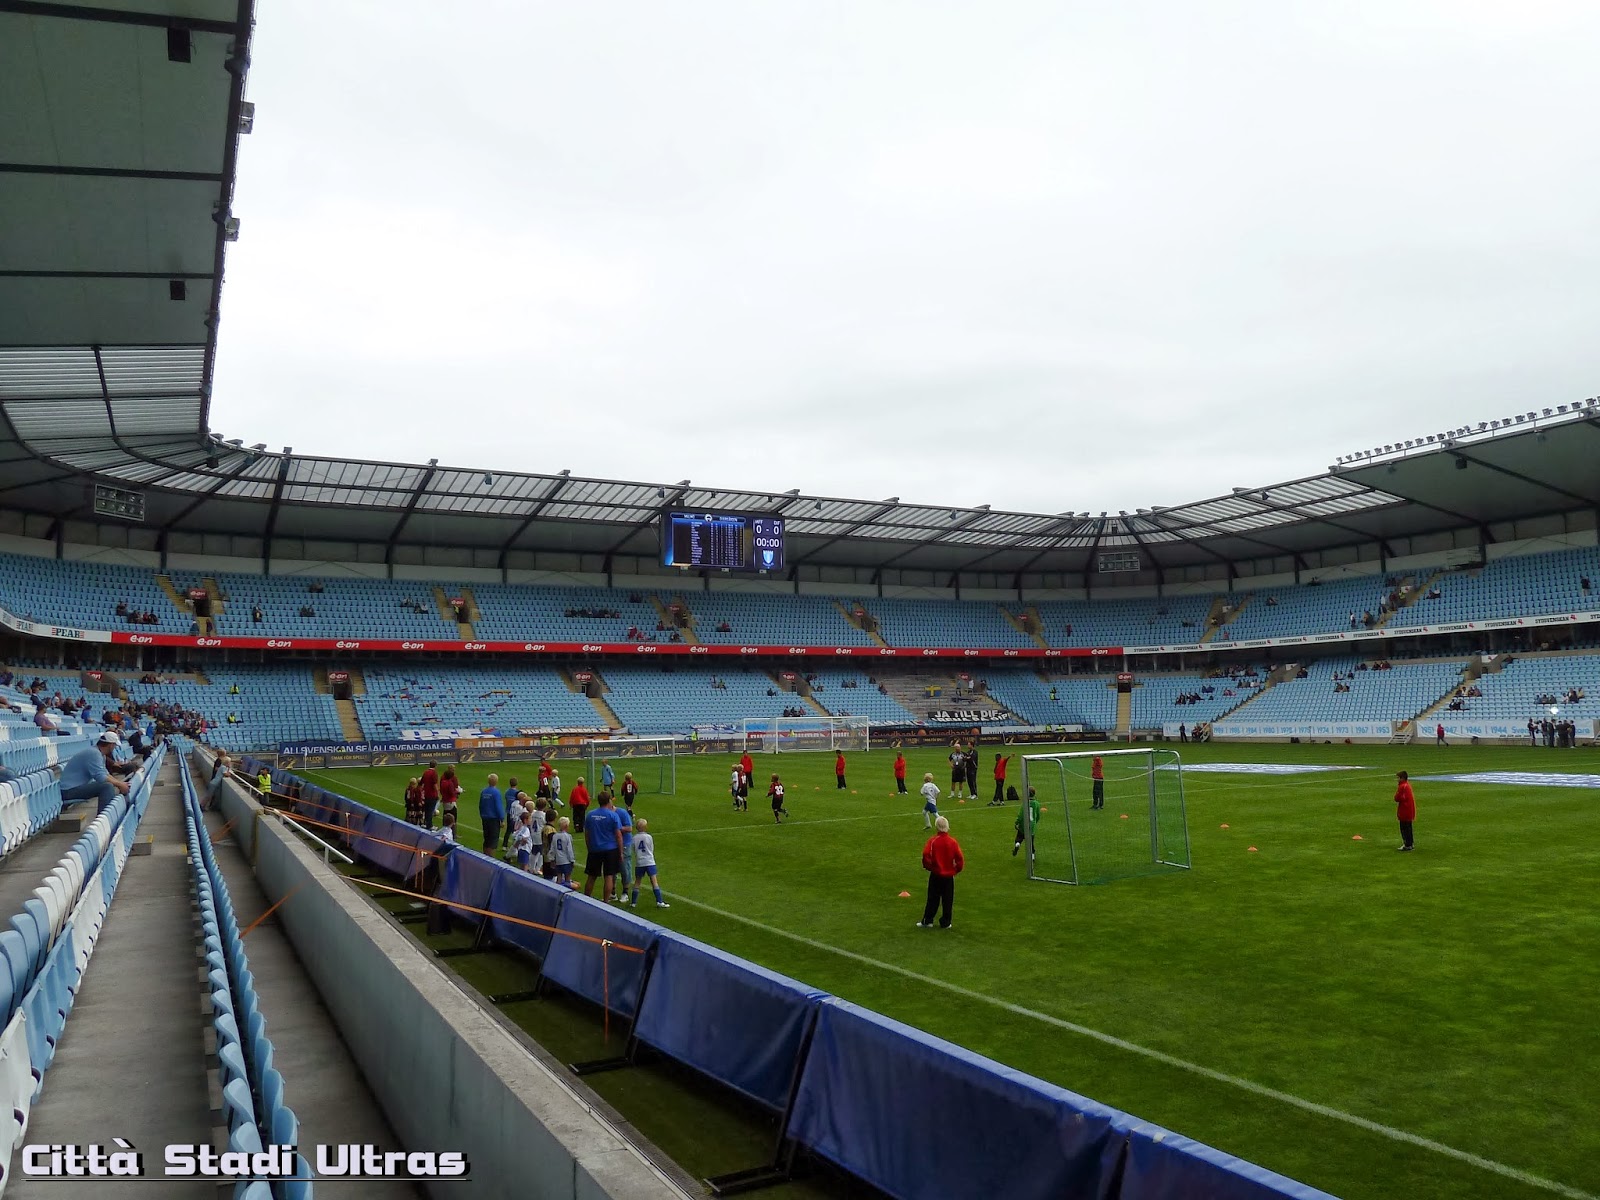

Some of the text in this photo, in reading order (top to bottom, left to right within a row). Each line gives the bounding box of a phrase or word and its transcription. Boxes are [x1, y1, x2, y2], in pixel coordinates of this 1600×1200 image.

[756, 525, 762, 534] 0
[774, 526, 779, 534] 0
[756, 538, 779, 547] 00:00
[283, 745, 368, 754] ALLSVENSKANSE
[626, 783, 632, 793] 9
[557, 839, 562, 850] 6
[638, 841, 646, 852] 4
